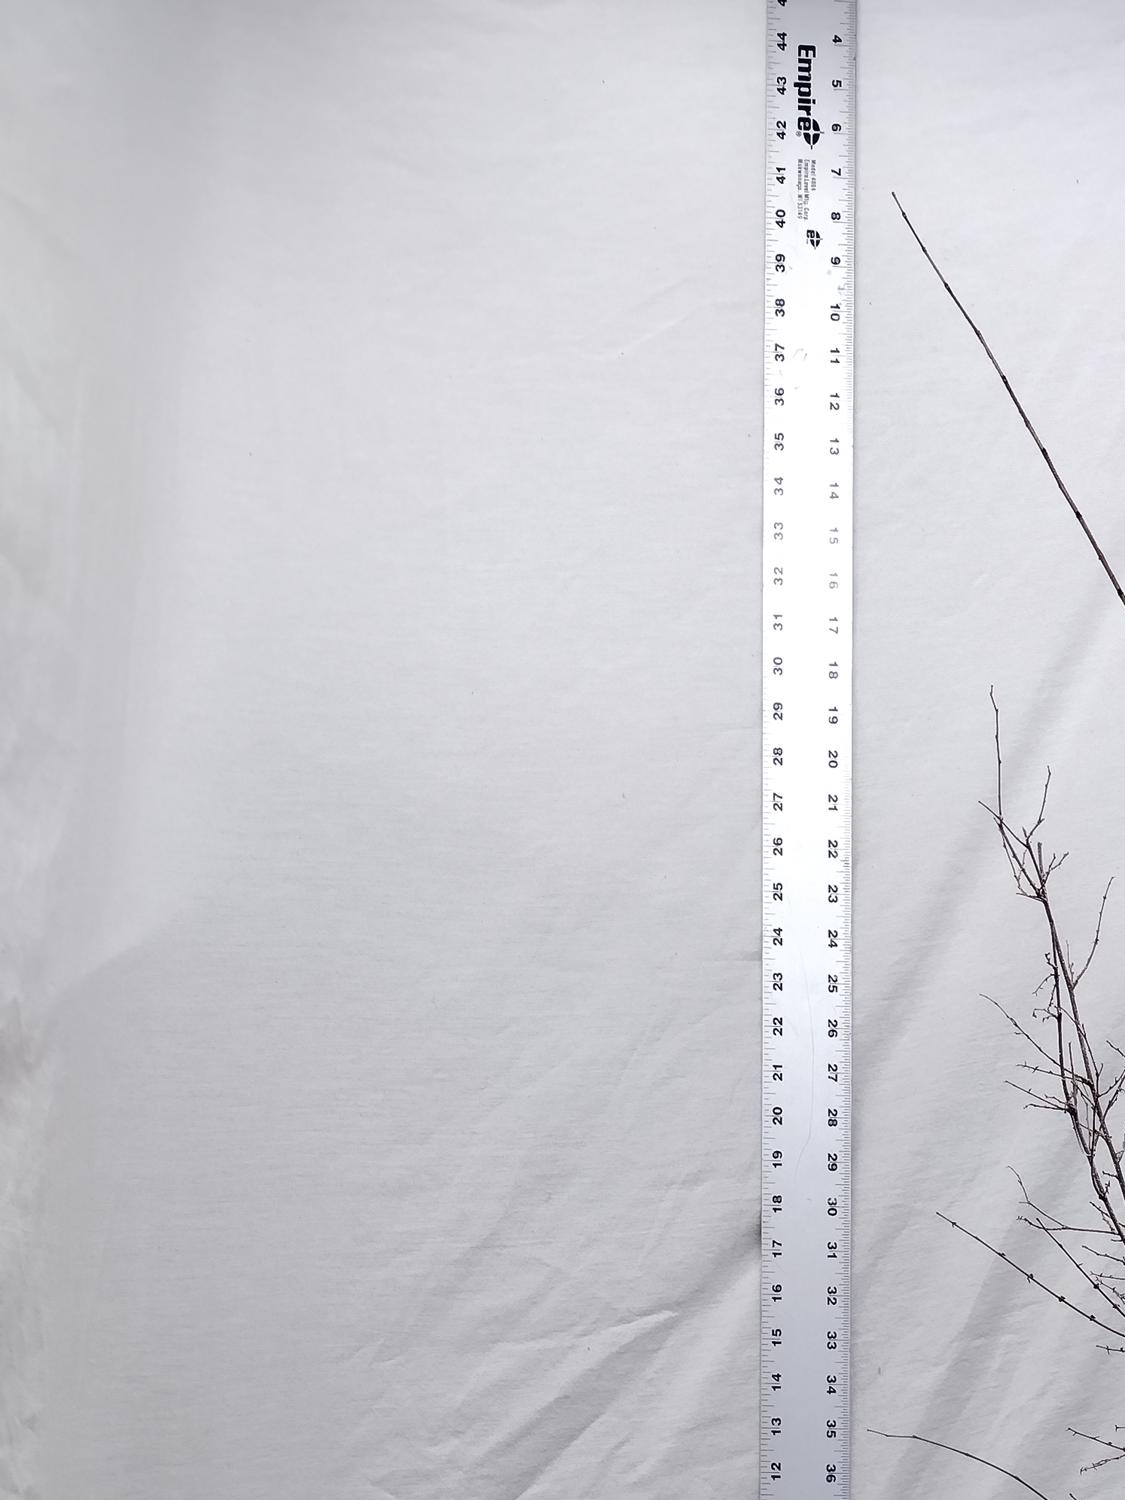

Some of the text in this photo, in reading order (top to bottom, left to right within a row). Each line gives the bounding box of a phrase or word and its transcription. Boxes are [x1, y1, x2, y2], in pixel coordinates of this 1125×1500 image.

[776, 31, 788, 52] 44
[832, 34, 843, 44] 4
[776, 76, 787, 96] 43
[793, 44, 817, 131] Empire
[831, 79, 842, 88] 5
[776, 120, 787, 140] 42
[831, 123, 842, 132] 6
[775, 166, 786, 185] 41
[831, 167, 842, 177] 7
[775, 209, 786, 229] 40
[830, 211, 841, 221] 8
[775, 253, 786, 273] 39
[830, 256, 841, 266] 9
[774, 298, 786, 318] 38
[830, 303, 841, 322] 10
[774, 343, 785, 363] 37
[830, 347, 841, 364] 11
[774, 387, 785, 406] 36
[829, 392, 840, 411] 12
[773, 432, 785, 451] 35
[829, 437, 840, 456] 13
[773, 476, 784, 496] 34
[829, 482, 840, 500] 14
[773, 521, 784, 541] 33
[829, 527, 839, 545] 15
[773, 566, 784, 586] 32
[828, 572, 839, 590] 16
[772, 614, 783, 632] 31
[828, 616, 839, 635] 17
[772, 656, 783, 676] 30
[828, 661, 839, 680] 18
[772, 702, 783, 721] 29
[828, 706, 839, 725] 19
[772, 747, 783, 767] 28
[828, 749, 839, 769] 20
[772, 792, 783, 812] 27
[827, 793, 839, 812] 21
[772, 837, 783, 857] 26
[827, 839, 839, 859] 22
[772, 882, 783, 902] 25
[827, 884, 839, 904] 23
[772, 927, 783, 947] 24
[827, 929, 839, 949] 24
[772, 972, 783, 992] 23
[827, 974, 838, 993] 25
[772, 1017, 783, 1037] 22
[827, 1018, 838, 1038] 26
[772, 1064, 783, 1082] 21
[827, 1063, 838, 1083] 27
[772, 1106, 783, 1126] 20
[827, 1108, 838, 1128] 28
[772, 1150, 783, 1169] 19
[827, 1152, 838, 1172] 29
[772, 1195, 783, 1214] 18
[827, 1197, 838, 1217] 30
[771, 1239, 783, 1258] 17
[827, 1241, 838, 1259] 31
[771, 1284, 783, 1303] 16
[826, 1286, 838, 1306] 32
[771, 1328, 782, 1347] 15
[826, 1330, 838, 1350] 33
[771, 1373, 782, 1392] 14
[826, 1375, 837, 1395] 34
[770, 1417, 782, 1436] 13
[826, 1419, 837, 1439] 35
[770, 1462, 782, 1481] 12
[825, 1463, 837, 1483] 36
